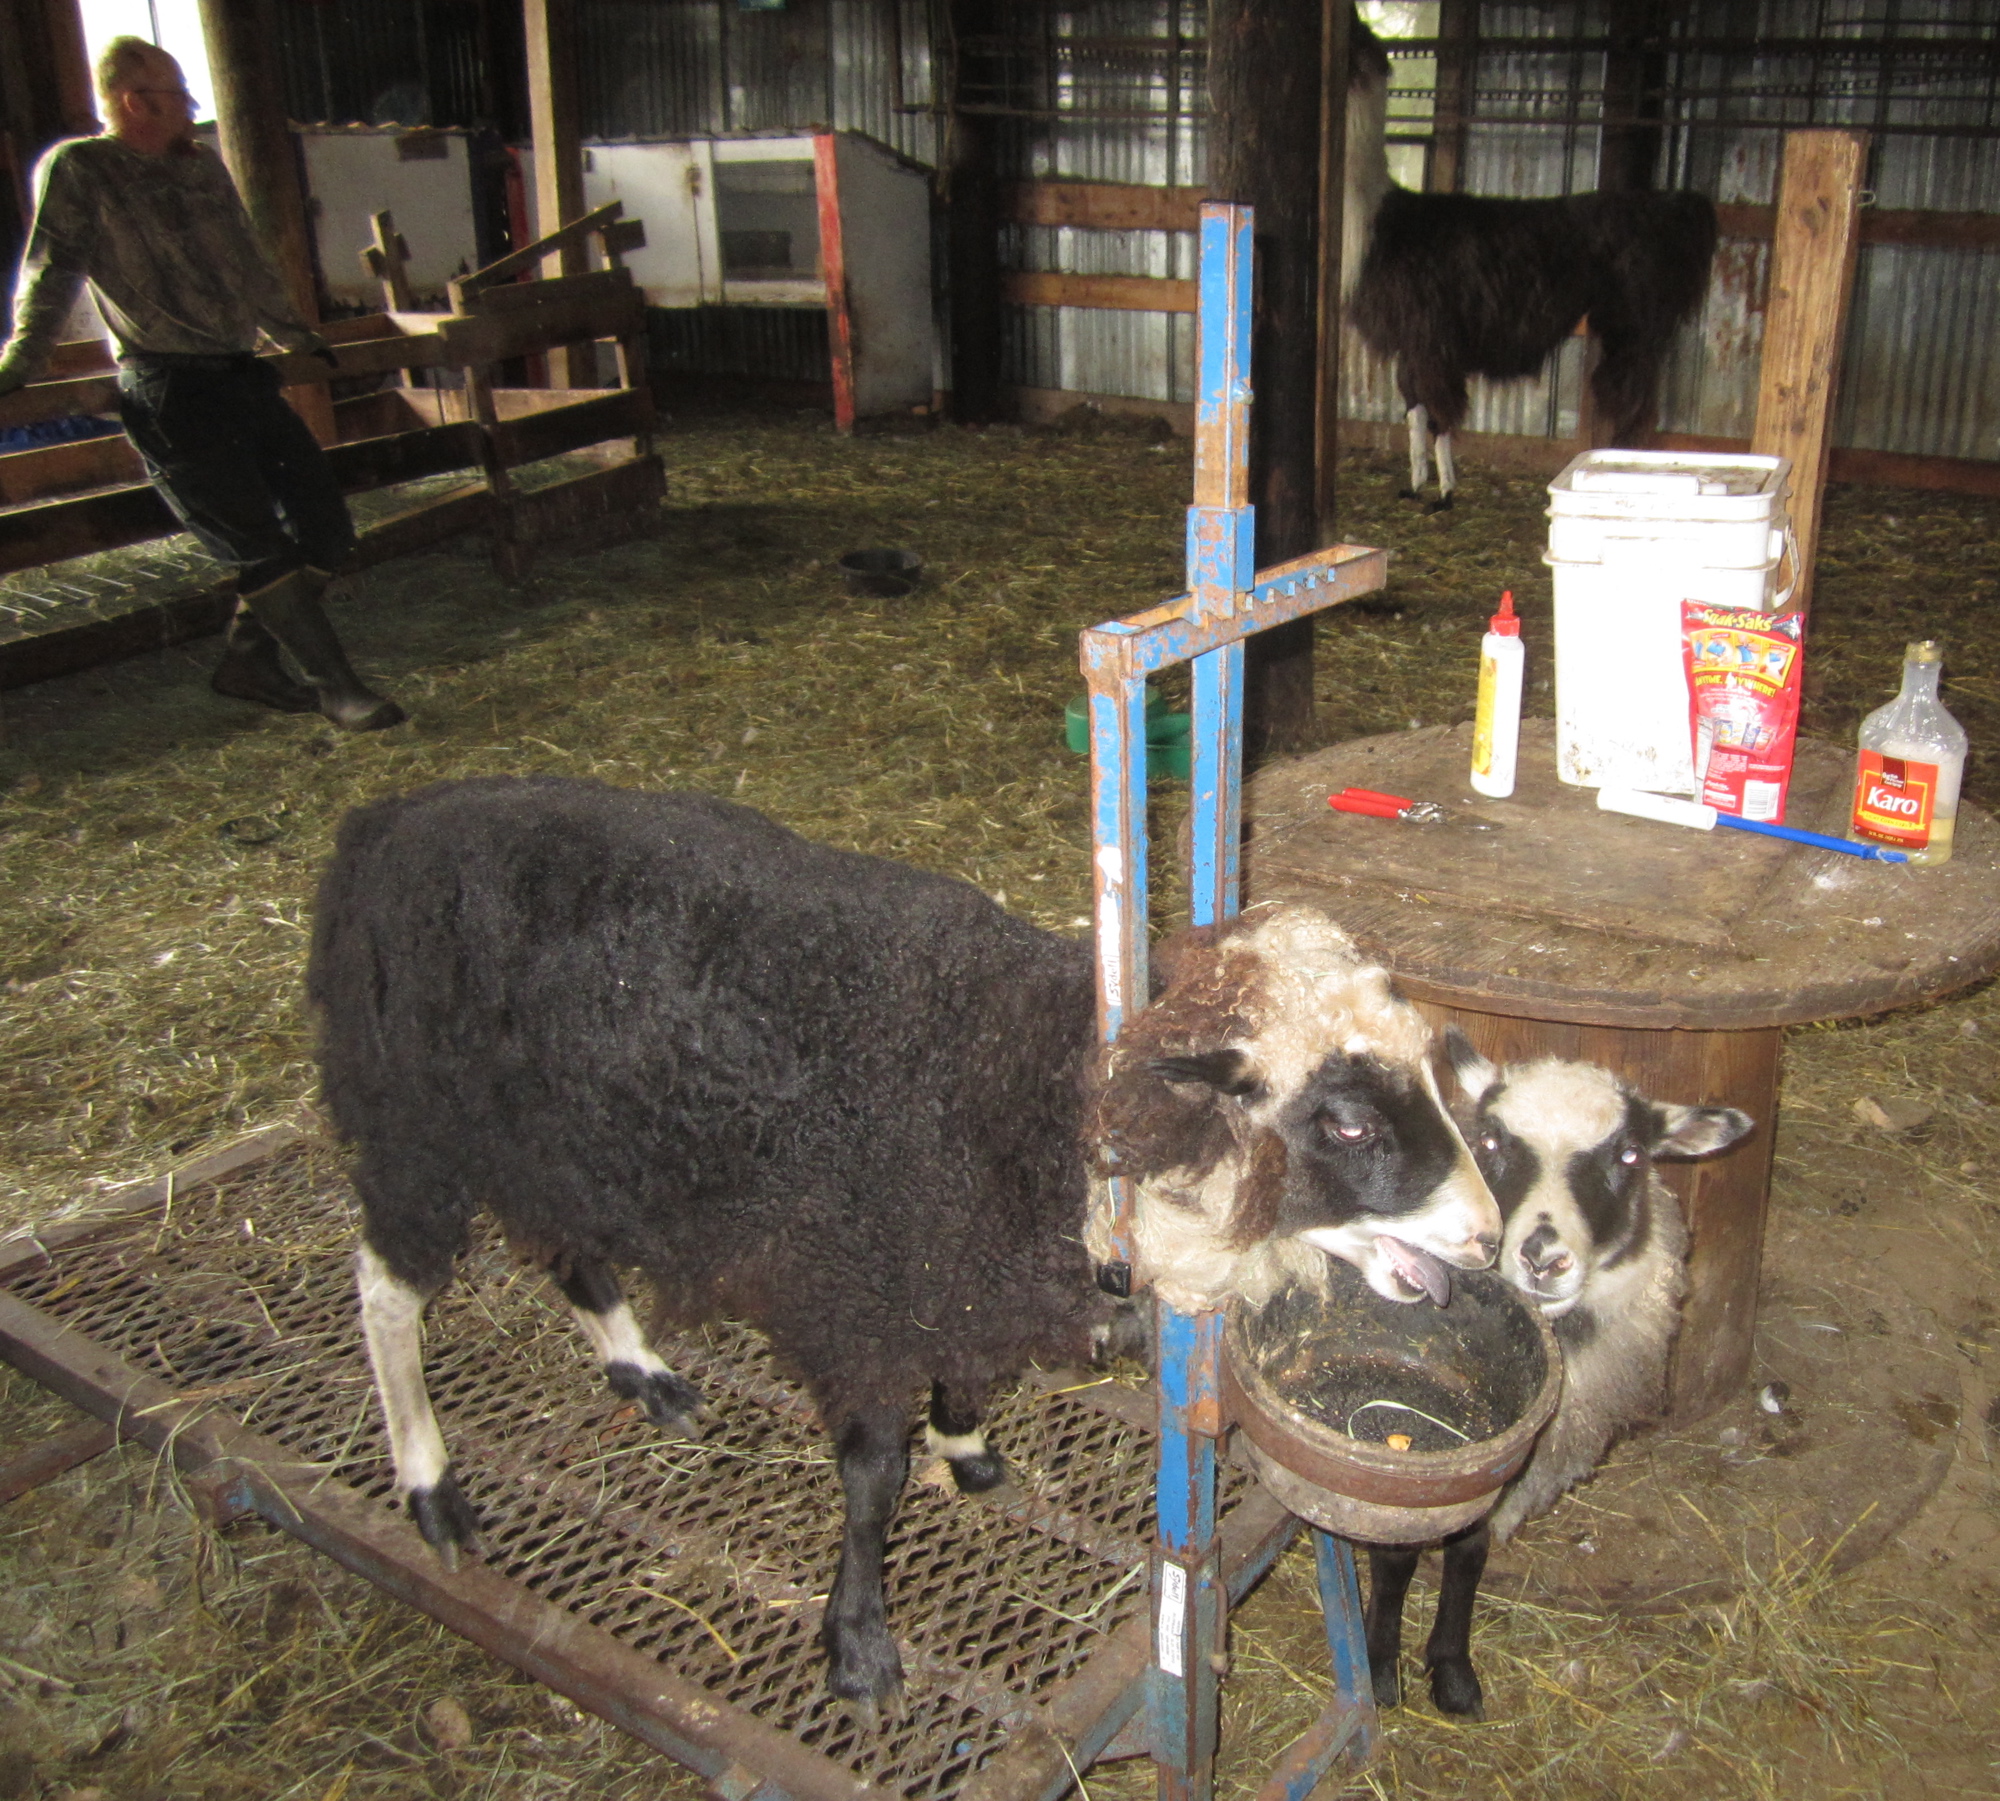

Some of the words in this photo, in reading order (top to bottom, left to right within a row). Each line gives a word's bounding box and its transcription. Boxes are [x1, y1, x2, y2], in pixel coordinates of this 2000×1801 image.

[1867, 786, 1918, 815] Karo
[1107, 960, 1120, 997] Sydell
[1168, 1570, 1181, 1600] Sydell
